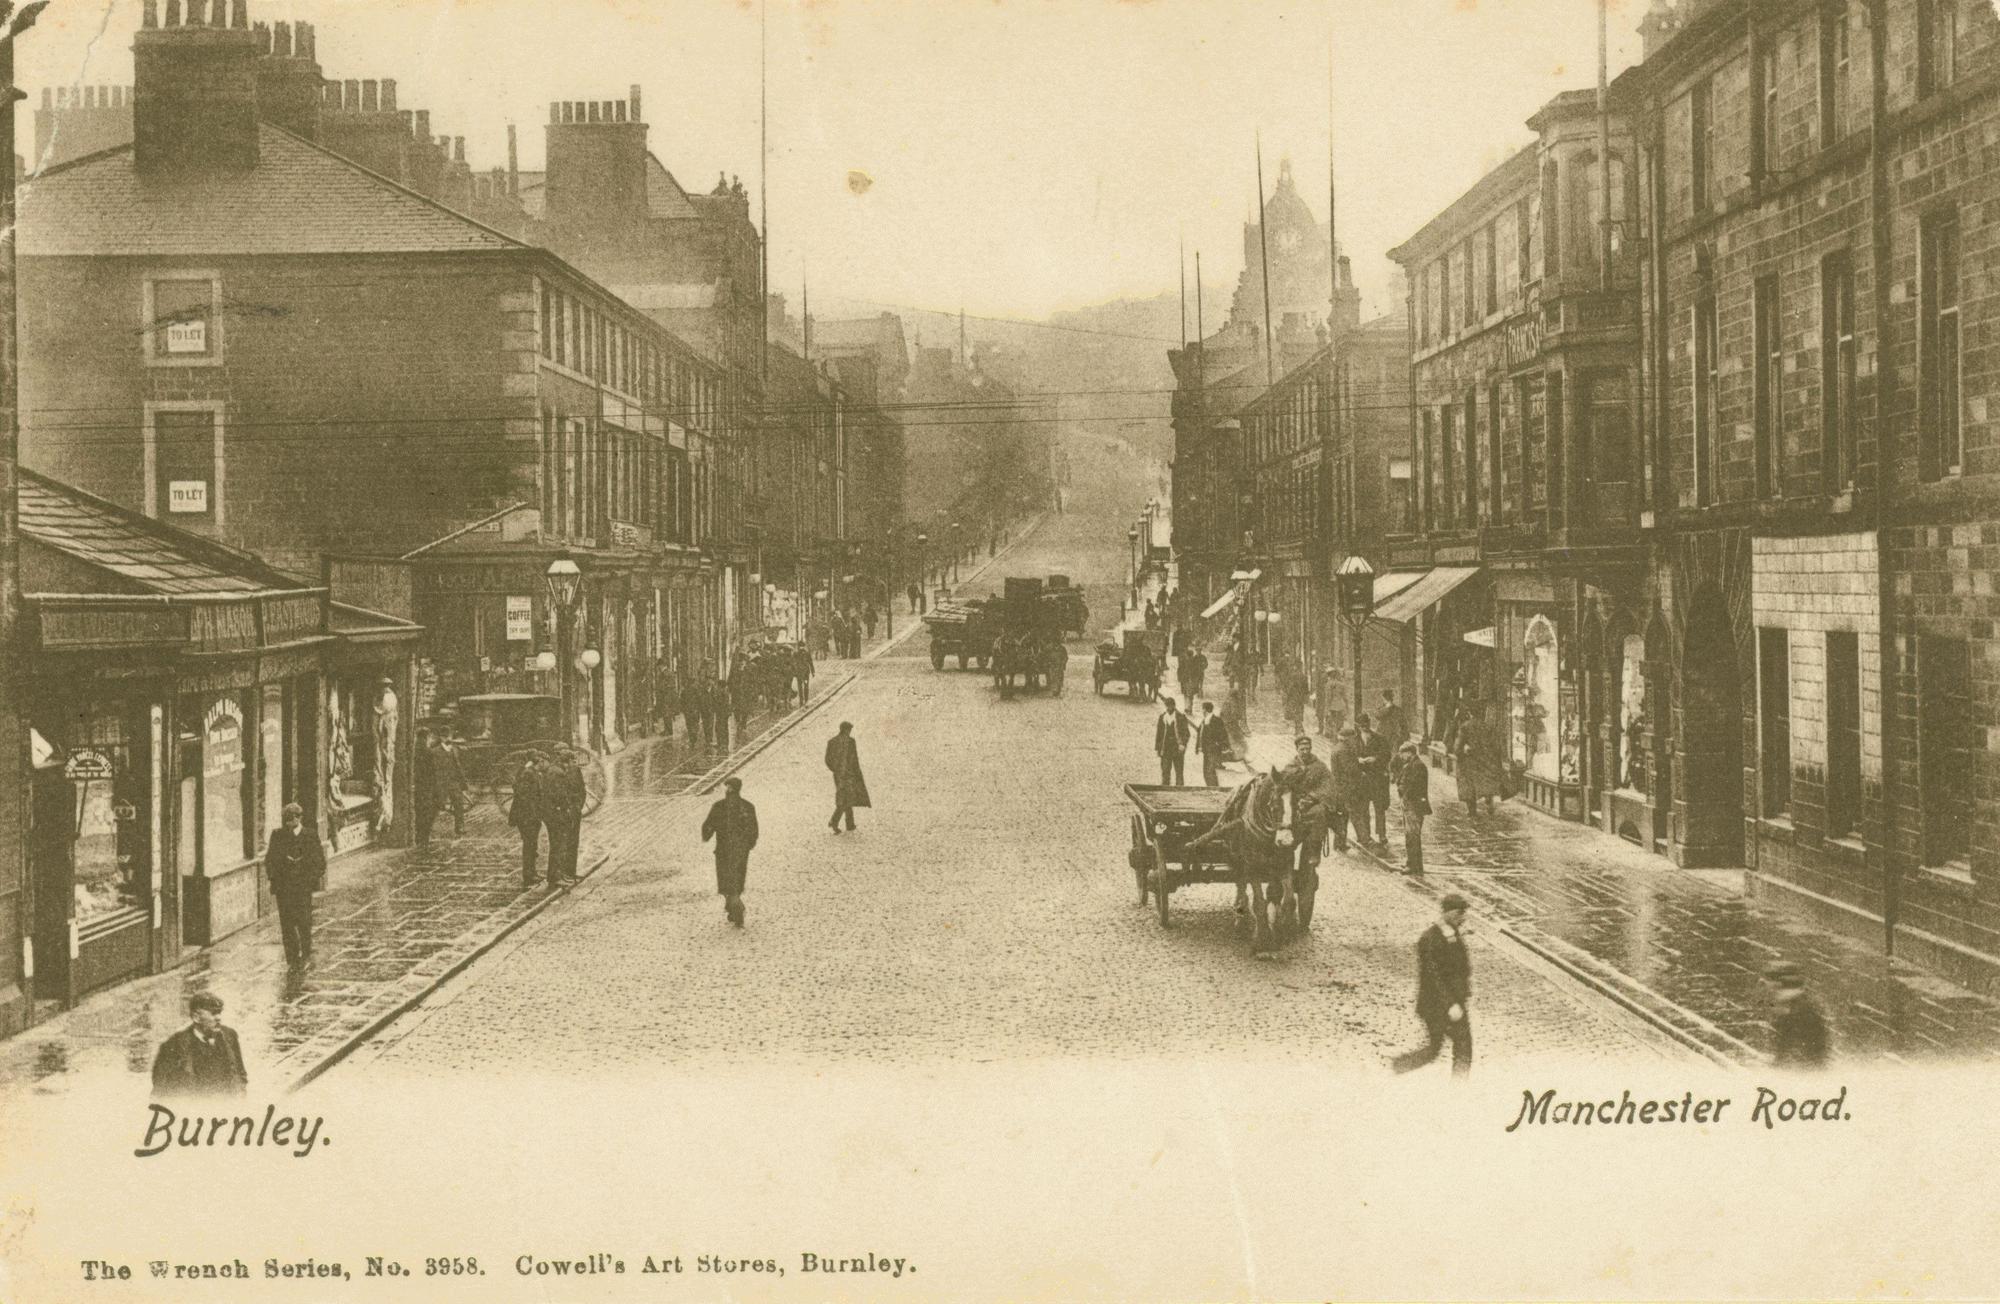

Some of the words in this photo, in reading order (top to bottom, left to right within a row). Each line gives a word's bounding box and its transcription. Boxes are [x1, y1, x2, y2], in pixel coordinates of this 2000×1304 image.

[171, 329, 182, 340] TO
[184, 329, 202, 340] LET
[172, 489, 184, 501] TO
[186, 489, 203, 500] LET
[507, 610, 531, 621] COFFEE
